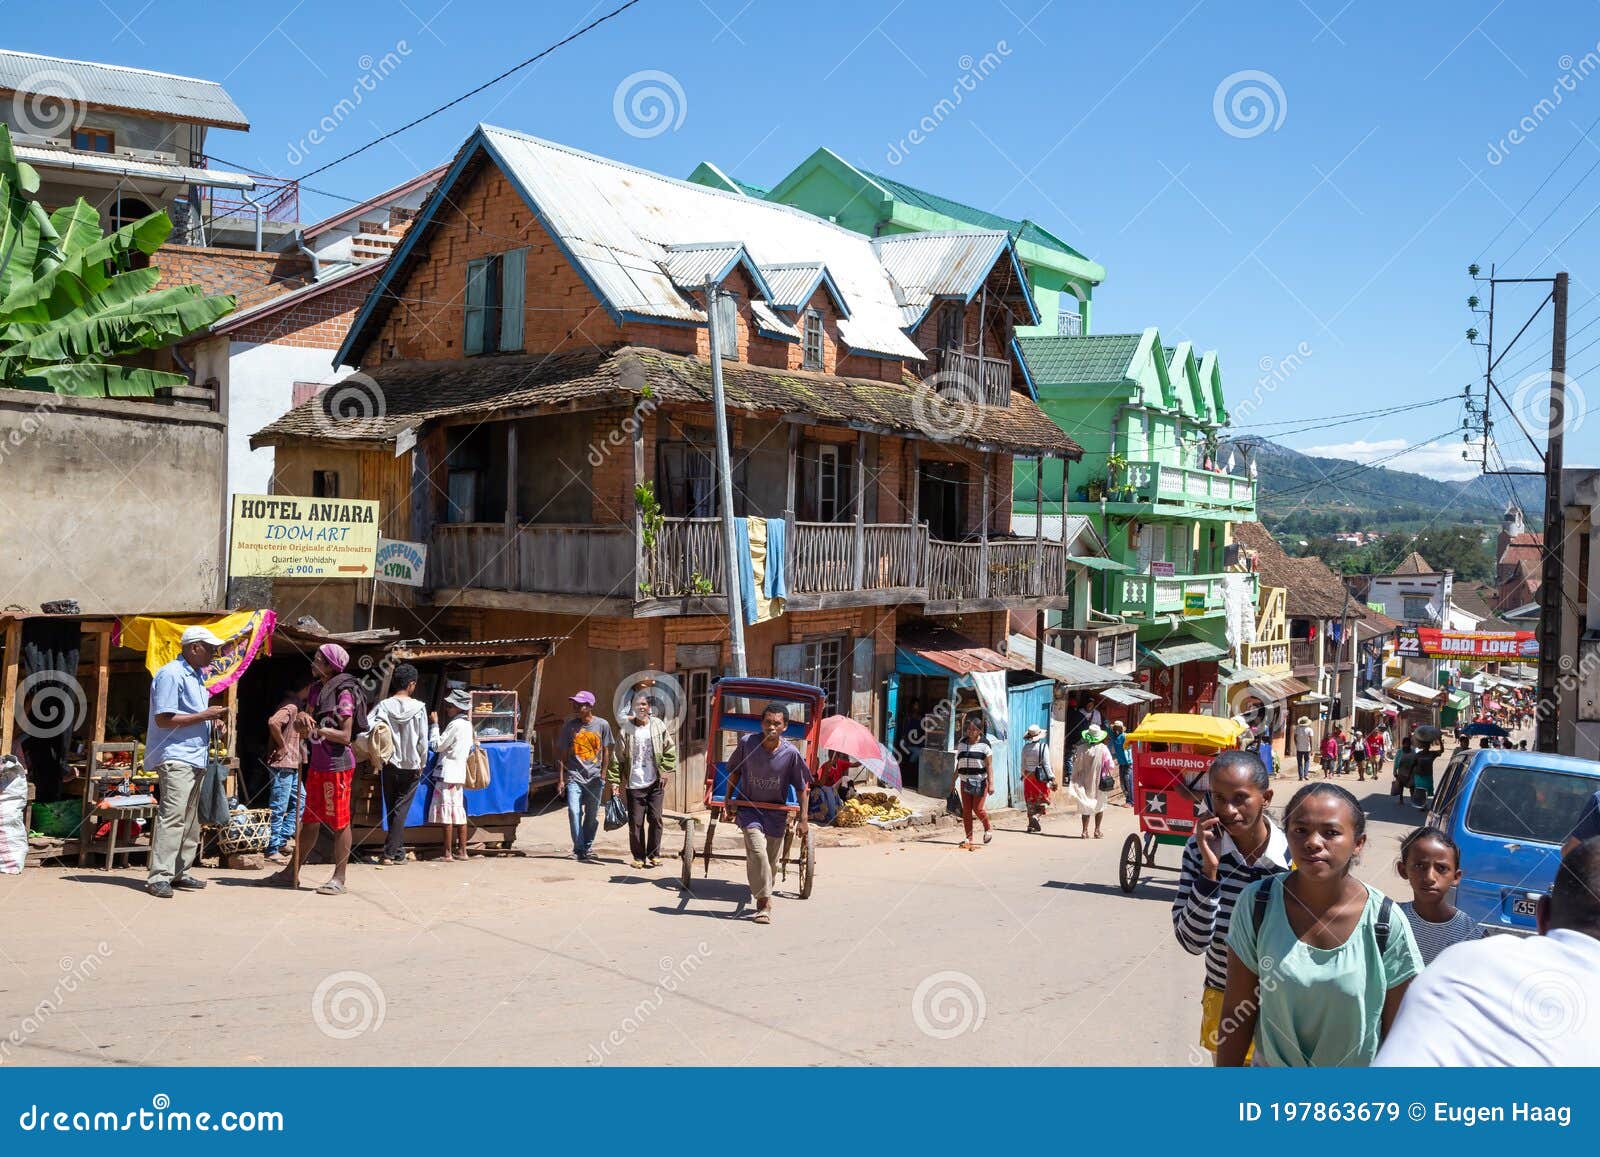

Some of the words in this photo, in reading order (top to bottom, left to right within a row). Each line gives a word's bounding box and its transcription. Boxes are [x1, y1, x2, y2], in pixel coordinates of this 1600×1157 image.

[241, 500, 302, 521] HOTEL
[308, 503, 374, 524] ANJARA
[237, 541, 286, 552] Marqueterie
[289, 543, 324, 553] Originale
[272, 555, 302, 563] Quartier
[304, 556, 337, 565] Vohidahy
[376, 543, 423, 572] COIFFURE
[296, 565, 314, 574] 900
[384, 562, 412, 580] LYDIA
[1399, 637, 1419, 651] 22
[1441, 637, 1475, 652] DADI
[1482, 639, 1517, 653] LOVE
[1150, 756, 1205, 769] LOHARANO
